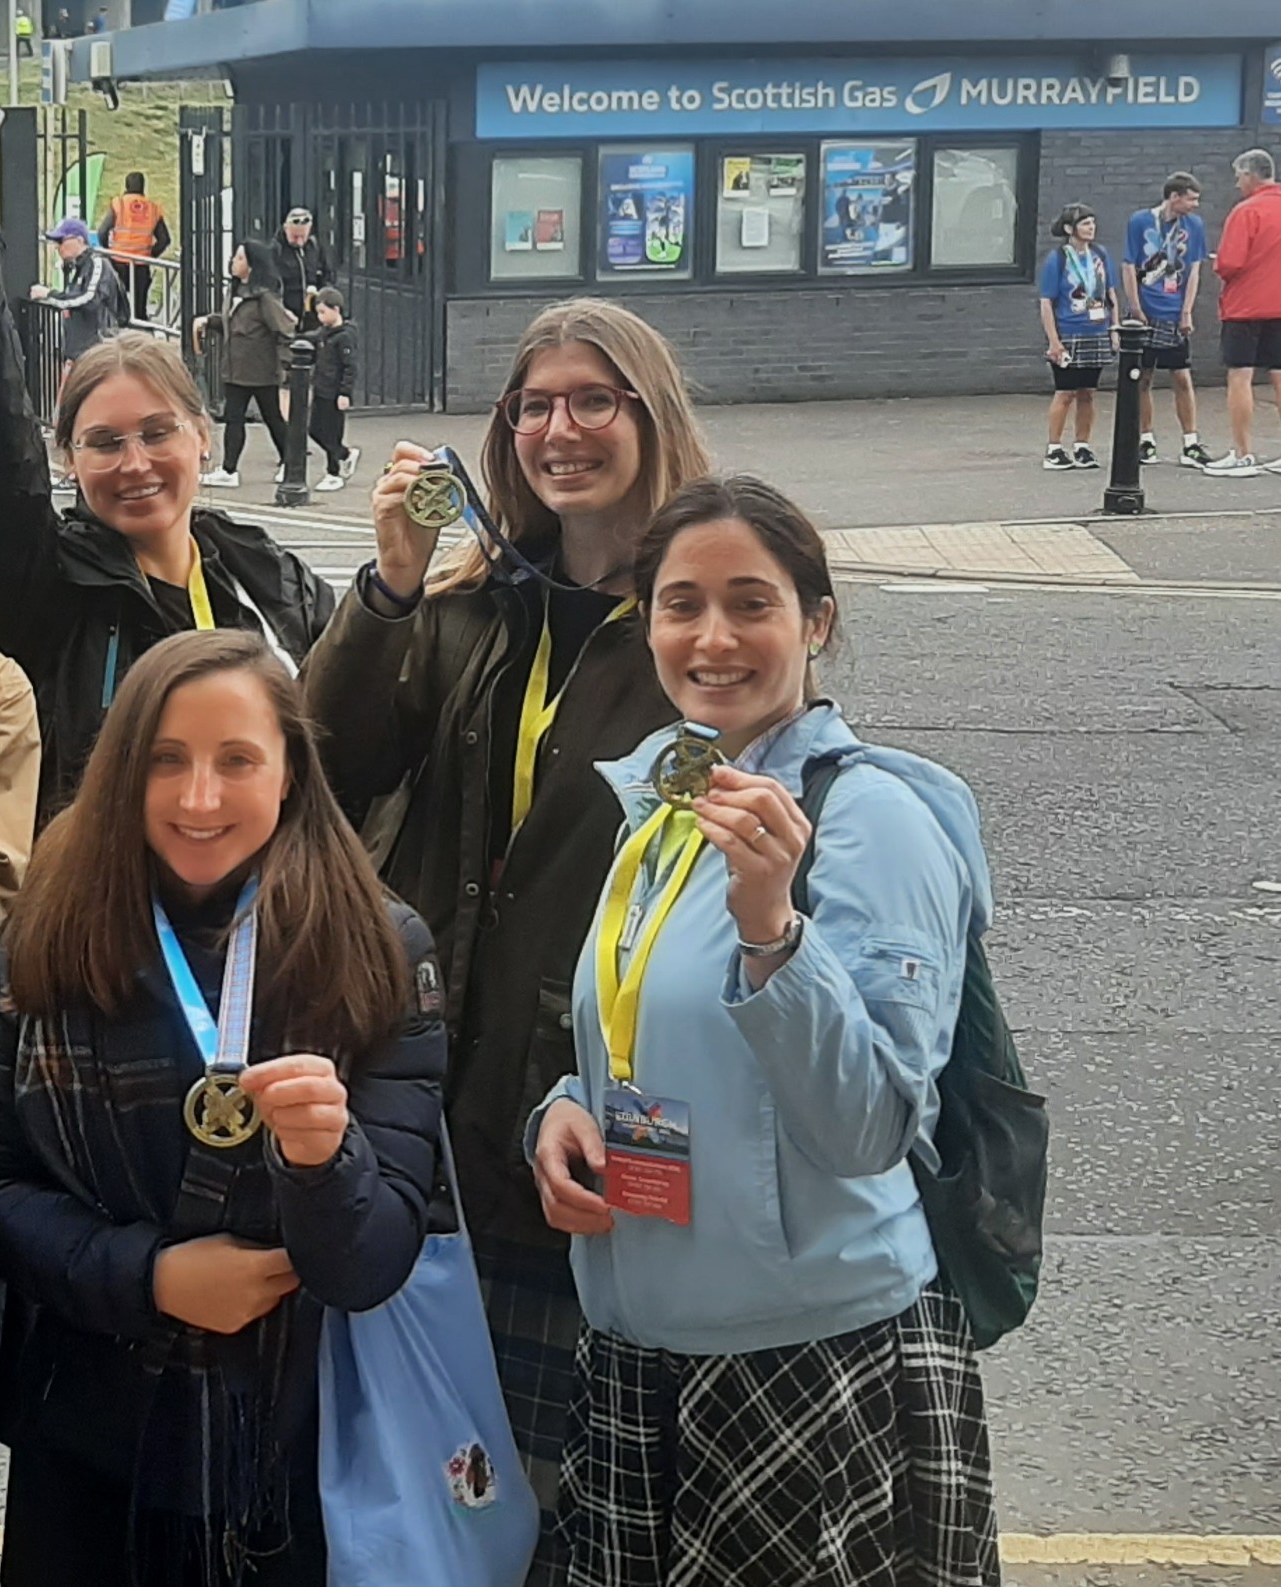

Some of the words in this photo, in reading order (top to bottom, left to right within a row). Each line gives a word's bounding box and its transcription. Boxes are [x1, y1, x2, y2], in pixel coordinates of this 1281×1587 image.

[506, 84, 660, 113] Welcome
[667, 84, 701, 111] to
[711, 80, 836, 112] Scottish
[843, 80, 898, 109] Gas
[960, 75, 1201, 107] MURRAYFIELD
